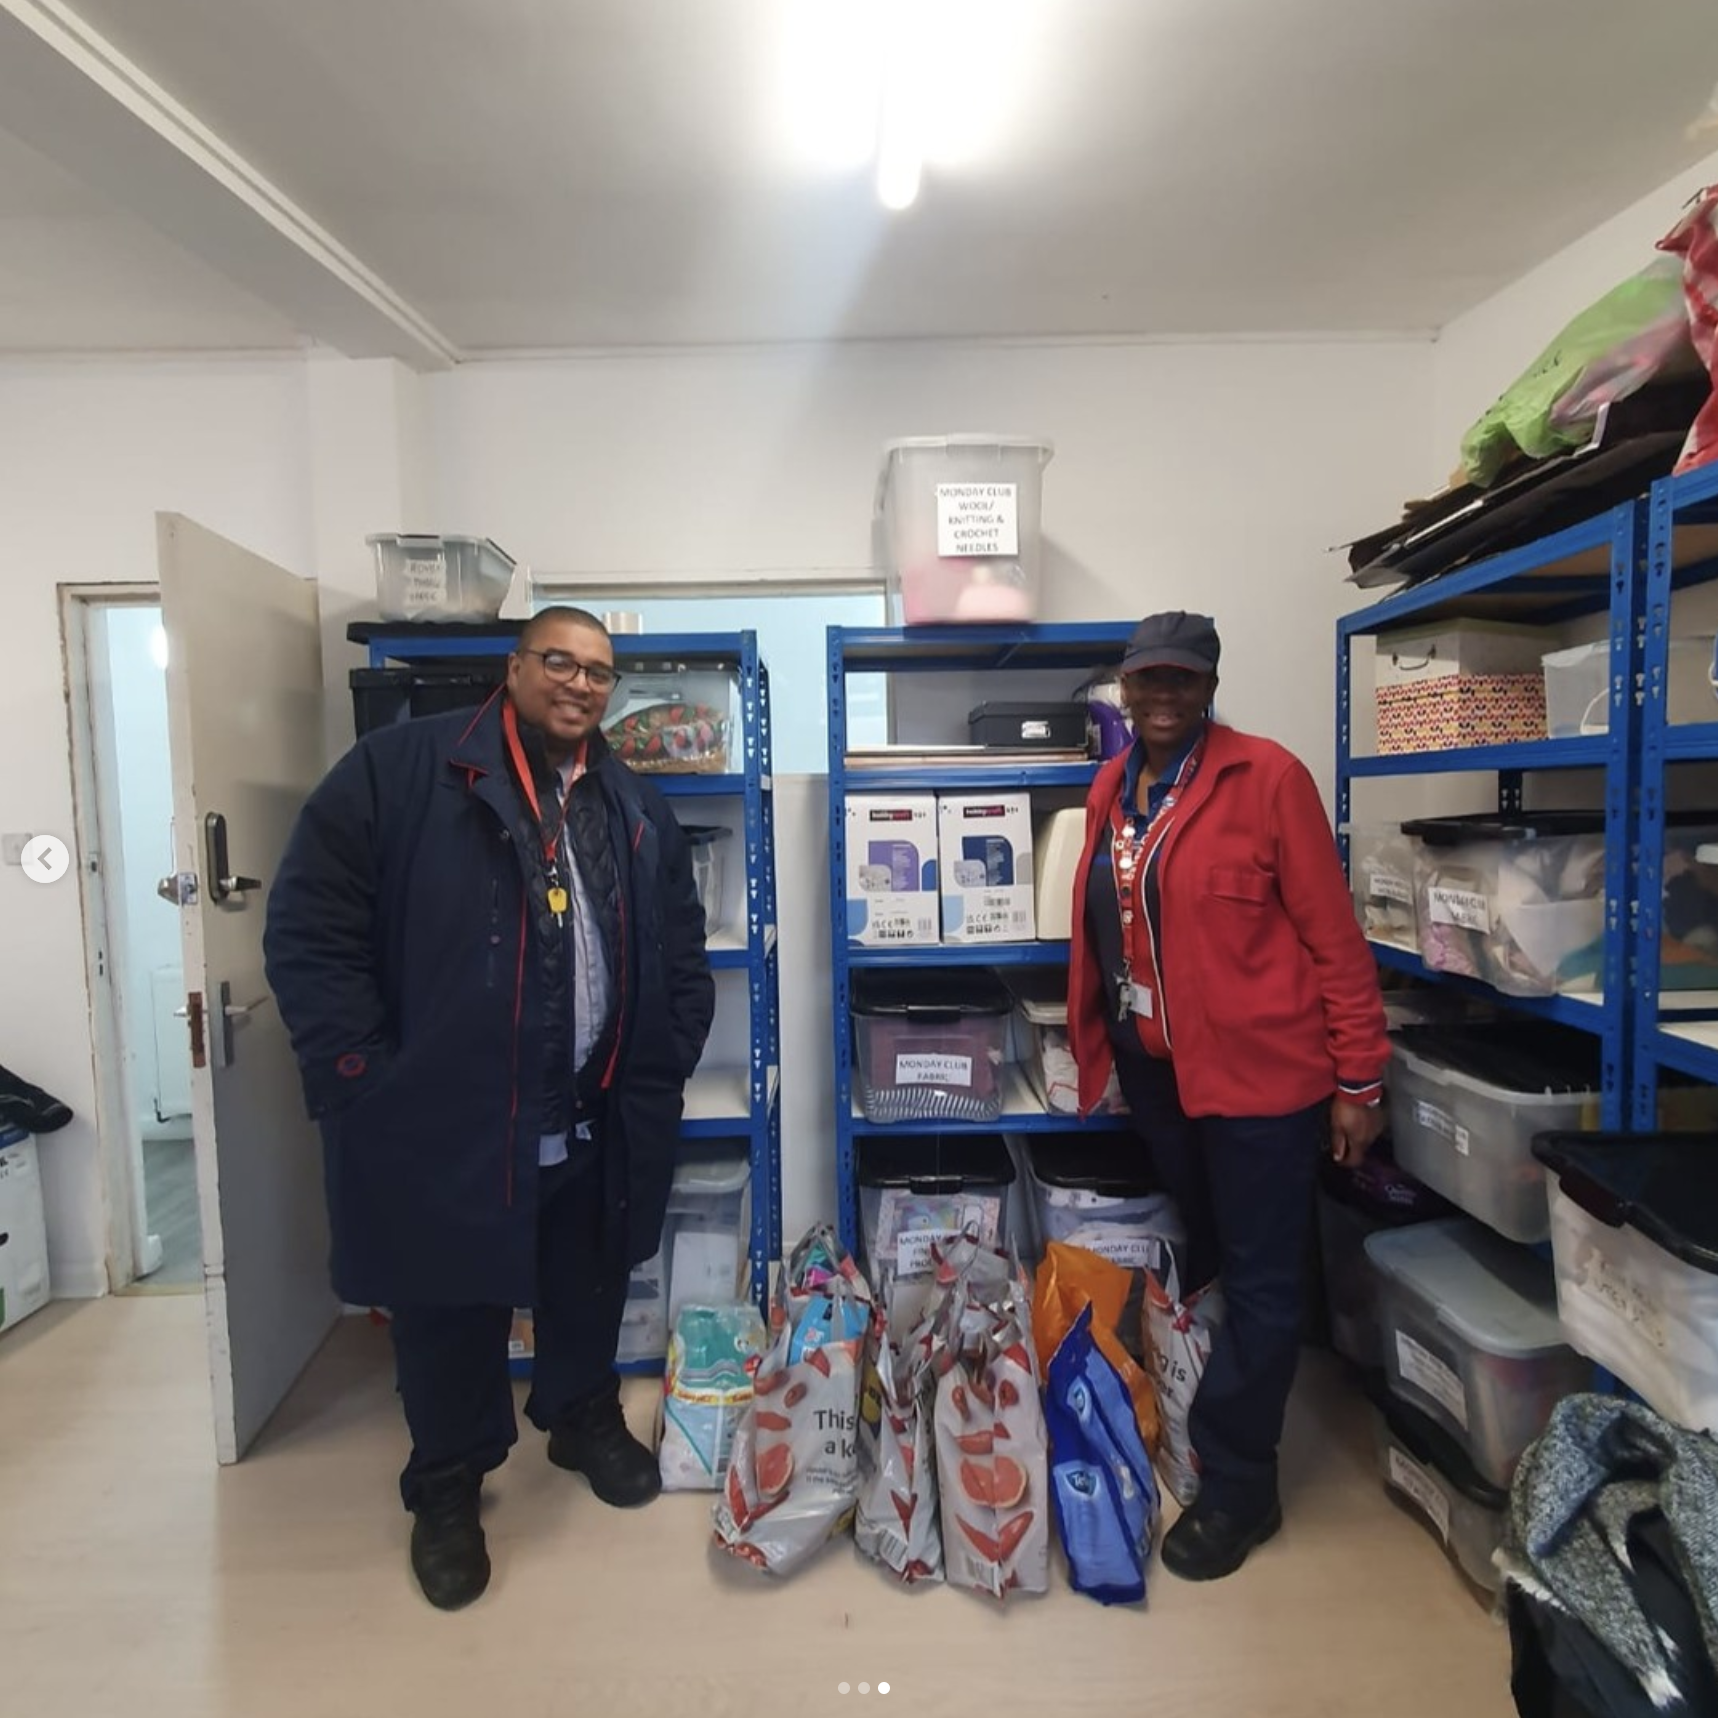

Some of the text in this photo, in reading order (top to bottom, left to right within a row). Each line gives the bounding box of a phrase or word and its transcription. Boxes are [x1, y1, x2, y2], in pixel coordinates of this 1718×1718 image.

[940, 487, 1011, 497] MONDAY CLUB
[948, 514, 1004, 525] KNITTING &
[953, 528, 999, 539] CROCHET
[956, 542, 999, 553] NEEDLES
[900, 1060, 967, 1070] MONDAY CLUB
[900, 1233, 942, 1245] MONDAY
[813, 1408, 855, 1430] This
[825, 1440, 836, 1455] a
